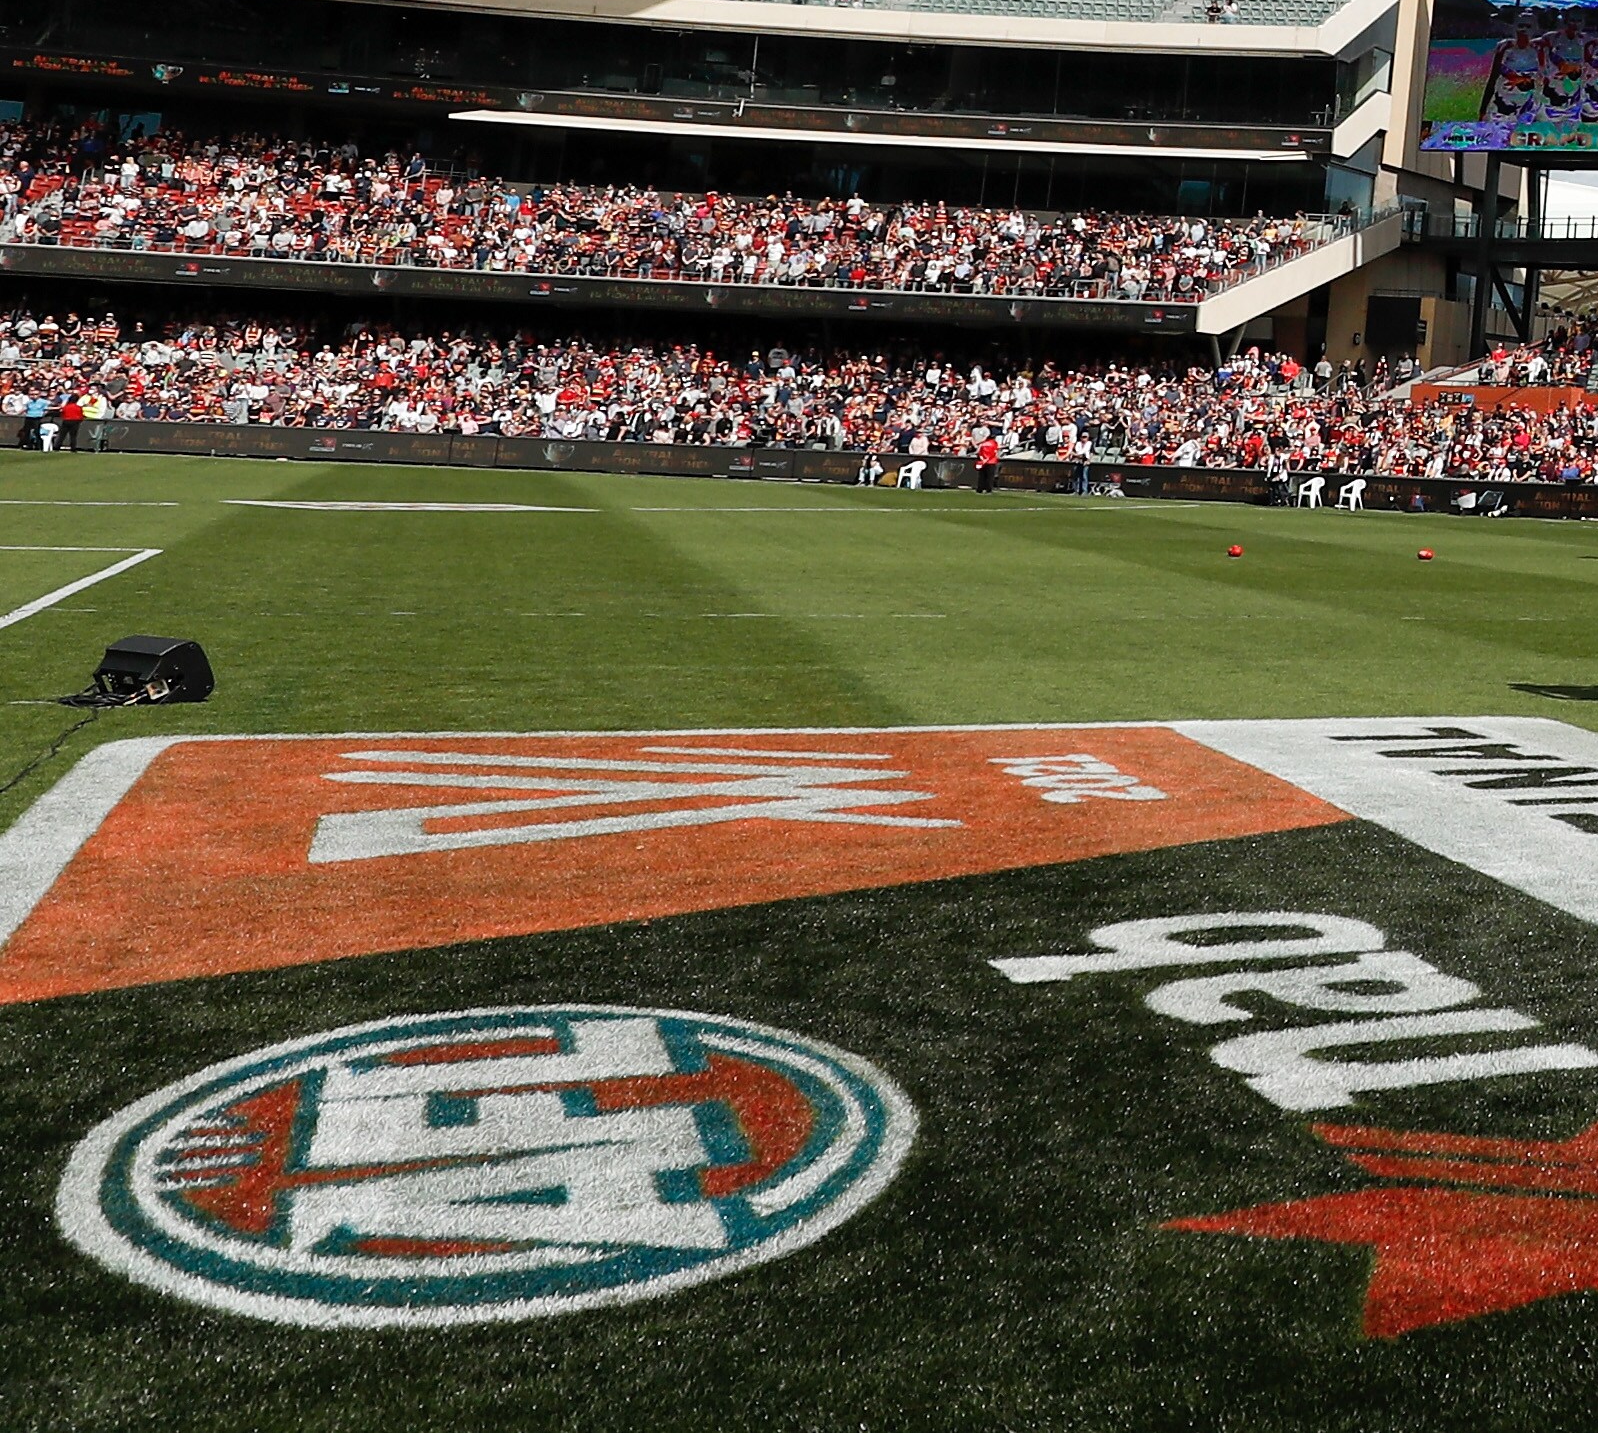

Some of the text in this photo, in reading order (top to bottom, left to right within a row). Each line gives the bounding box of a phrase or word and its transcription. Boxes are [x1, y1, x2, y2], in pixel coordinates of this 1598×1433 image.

[1510, 132, 1592, 146] GRAND
[986, 753, 1169, 804] 2021
[285, 1016, 731, 1252] AFL
